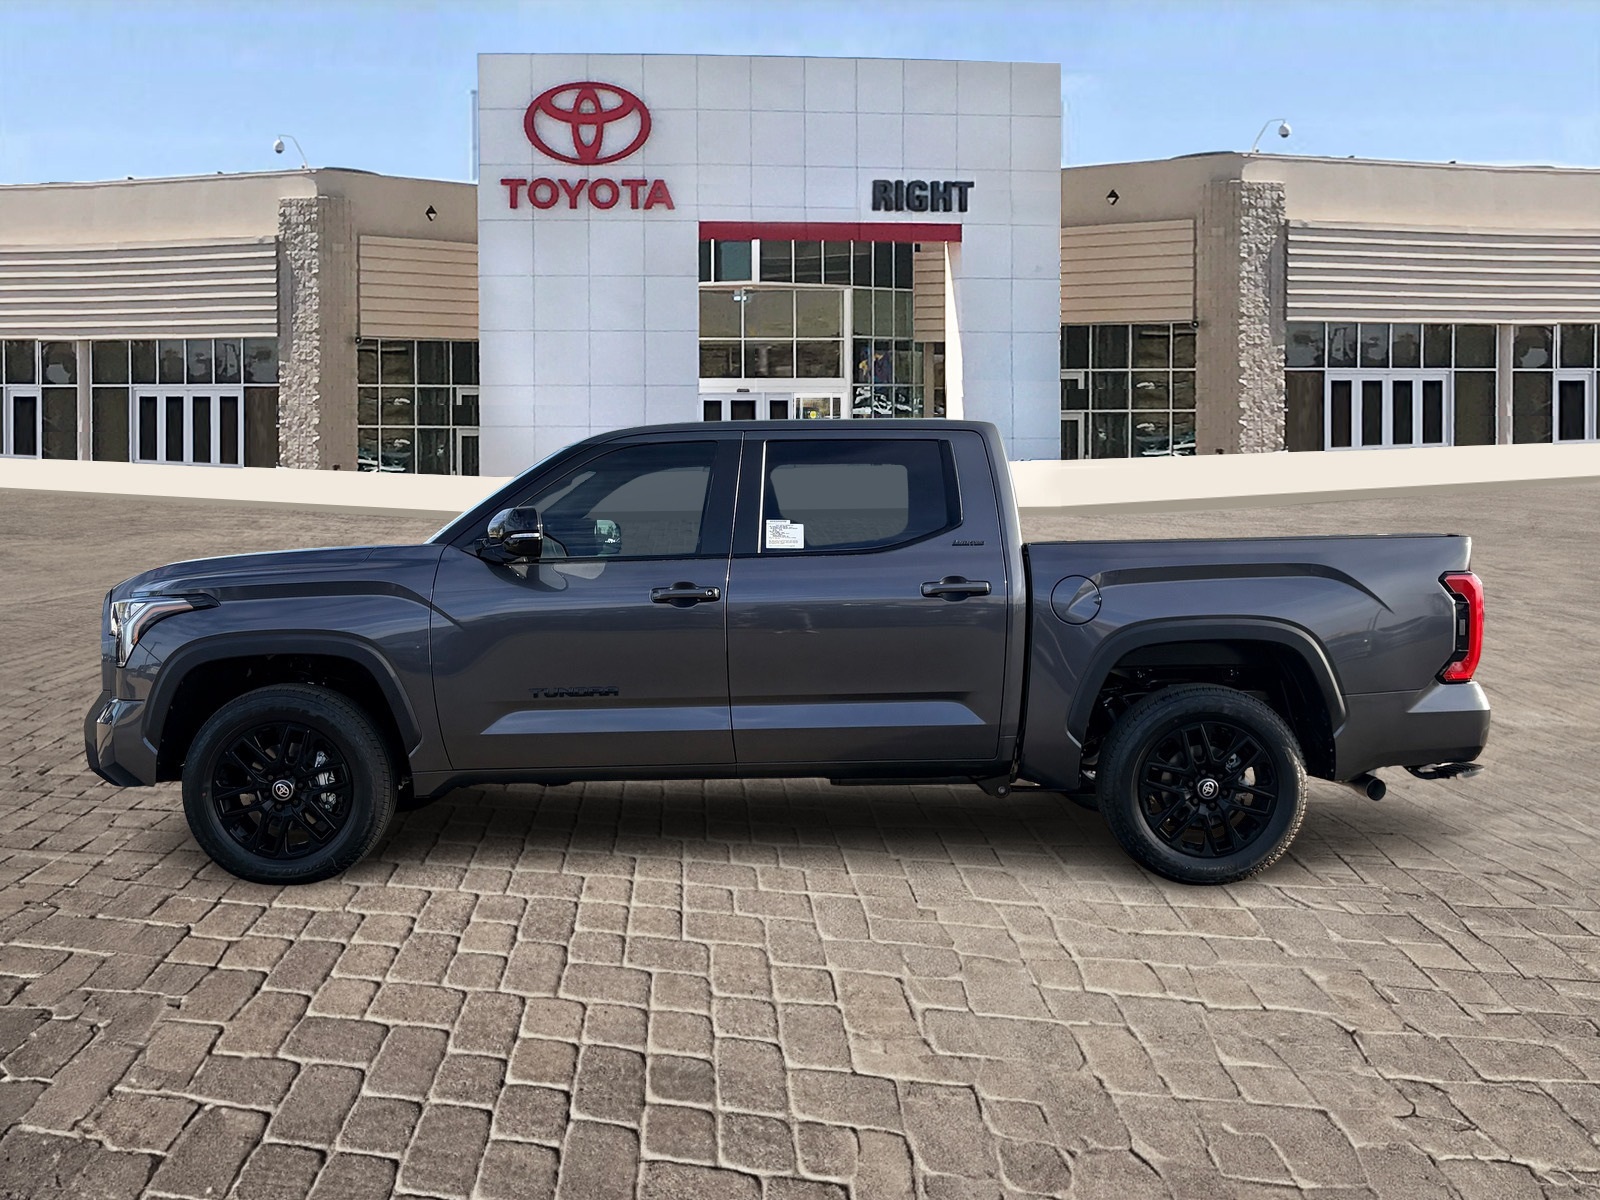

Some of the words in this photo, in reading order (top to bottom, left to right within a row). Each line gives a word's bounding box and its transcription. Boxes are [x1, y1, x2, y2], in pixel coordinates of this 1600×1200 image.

[500, 177, 676, 210] TOYOTA
[871, 179, 975, 212] RIGHT
[528, 685, 619, 699] TUNDRA
